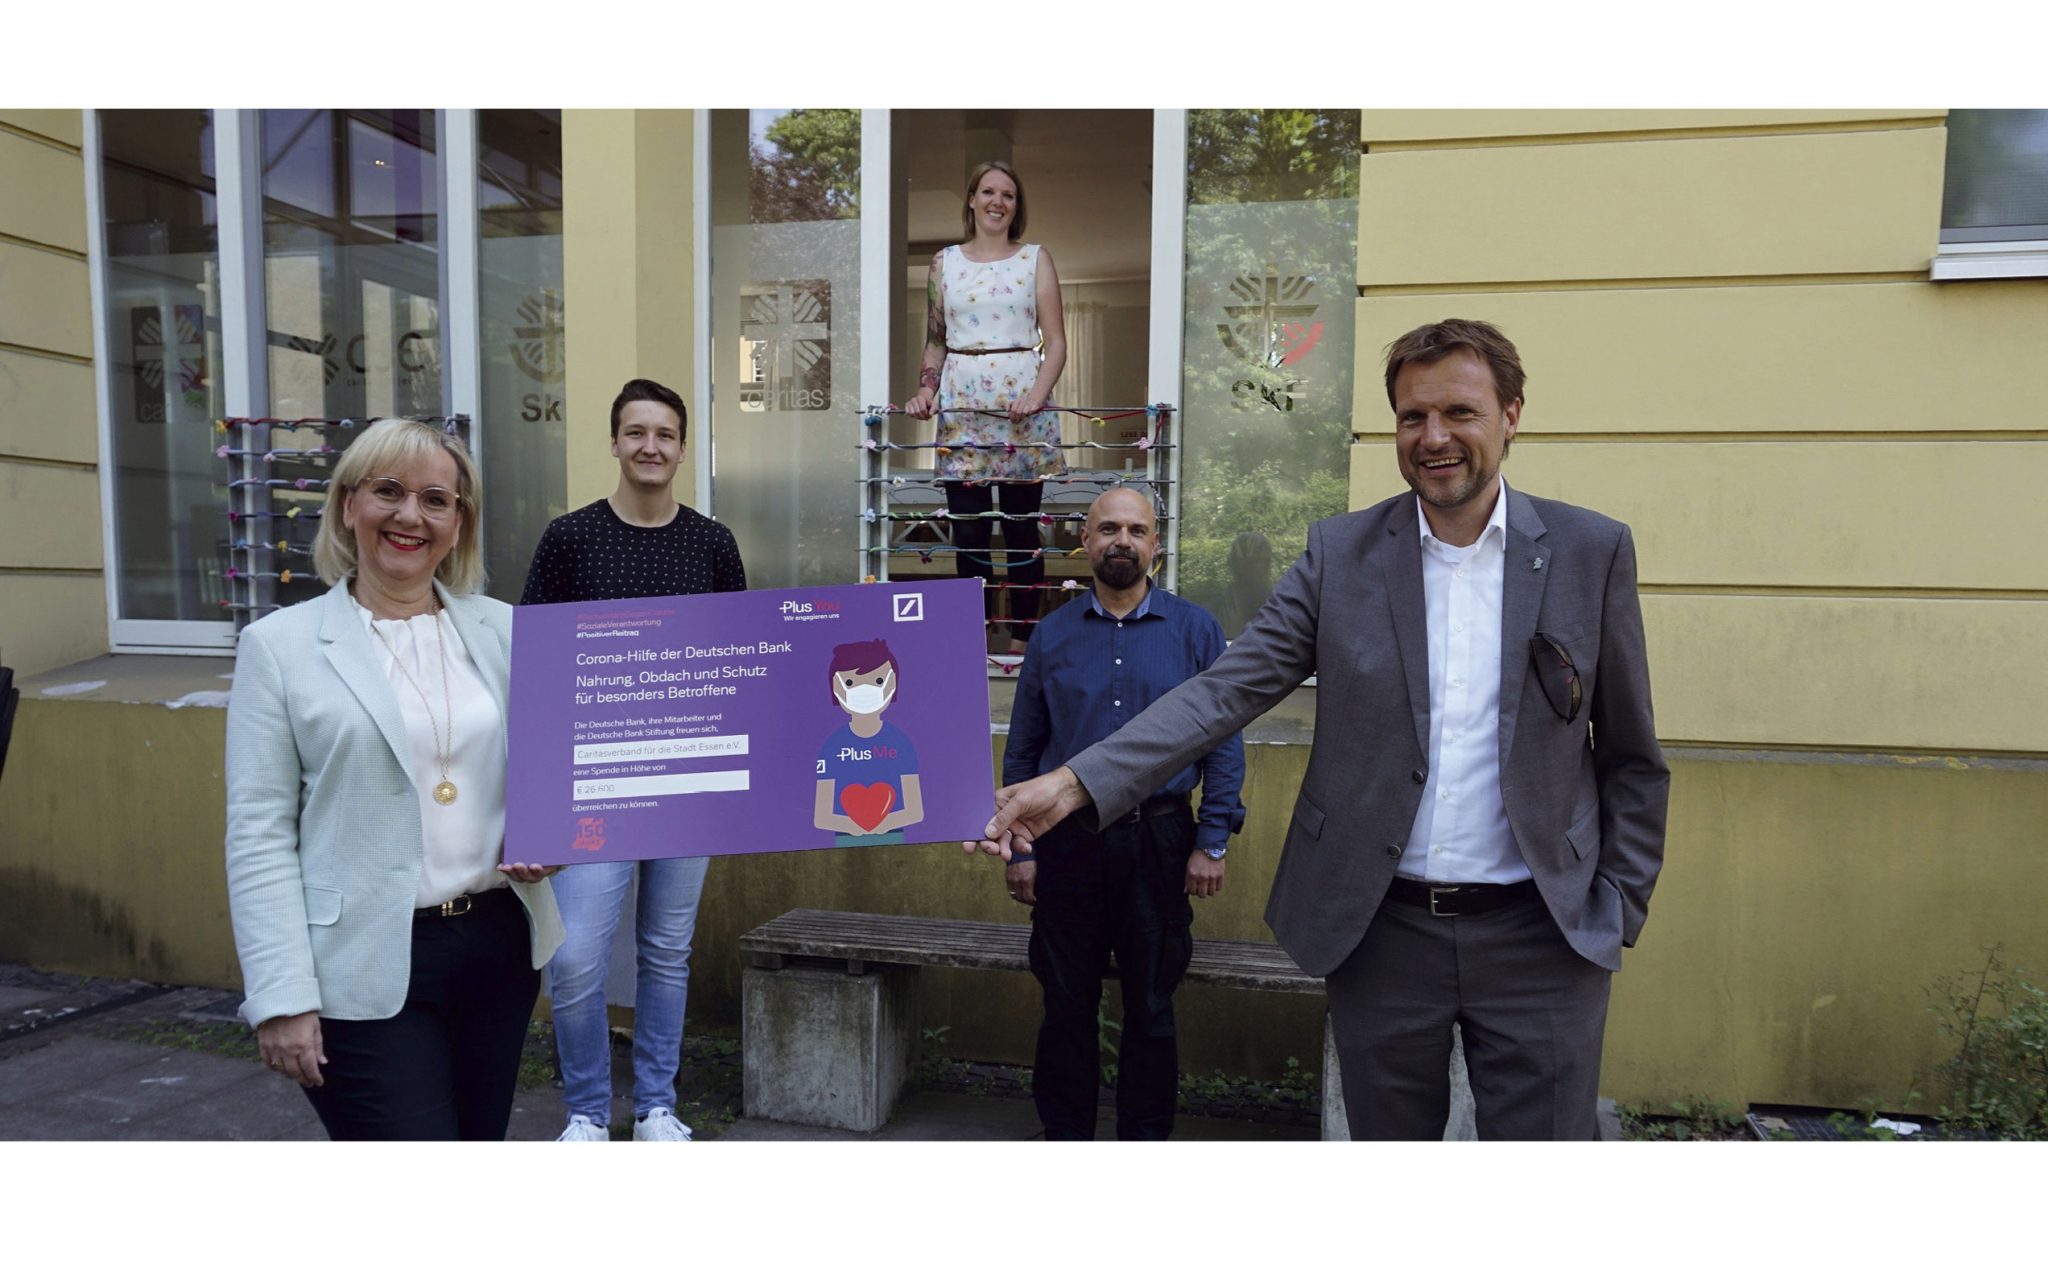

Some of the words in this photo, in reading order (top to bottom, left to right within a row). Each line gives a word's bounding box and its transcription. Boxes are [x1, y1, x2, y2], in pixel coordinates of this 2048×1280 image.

[747, 383, 824, 408] caritas
[521, 393, 562, 422] Sk
[576, 649, 657, 665] Corona-Hilfe
[660, 649, 682, 660] der
[685, 644, 755, 659] Deutschen
[758, 641, 793, 654] Bank
[576, 673, 636, 687] Nahrung,
[639, 670, 690, 684] Obdach
[694, 668, 719, 680] und
[722, 664, 768, 678] Schutz
[575, 692, 594, 705] für
[597, 689, 665, 704] besonders
[668, 683, 737, 699] Betroffene
[574, 721, 588, 730] Die
[589, 718, 625, 728] Deutsche
[626, 717, 647, 727] Bank,
[648, 717, 662, 725] ihre
[664, 714, 705, 724] Mitarbeiter
[707, 713, 722, 722] und
[574, 733, 586, 741] die
[587, 731, 624, 740] Deutsche
[624, 729, 645, 738] Bank
[645, 728, 676, 738] Stiftung
[676, 727, 700, 735] freuen
[577, 748, 642, 760] Caritasverband
[644, 746, 657, 755] für
[658, 745, 672, 755] die
[673, 742, 697, 754] Stadt
[699, 742, 724, 752] Essen
[726, 740, 741, 750] e.V.
[573, 769, 590, 777] eine
[590, 767, 620, 777] Spende
[630, 764, 651, 773] Höhe
[652, 763, 667, 771] von
[572, 803, 618, 812] überreichen
[629, 800, 659, 809] können.
